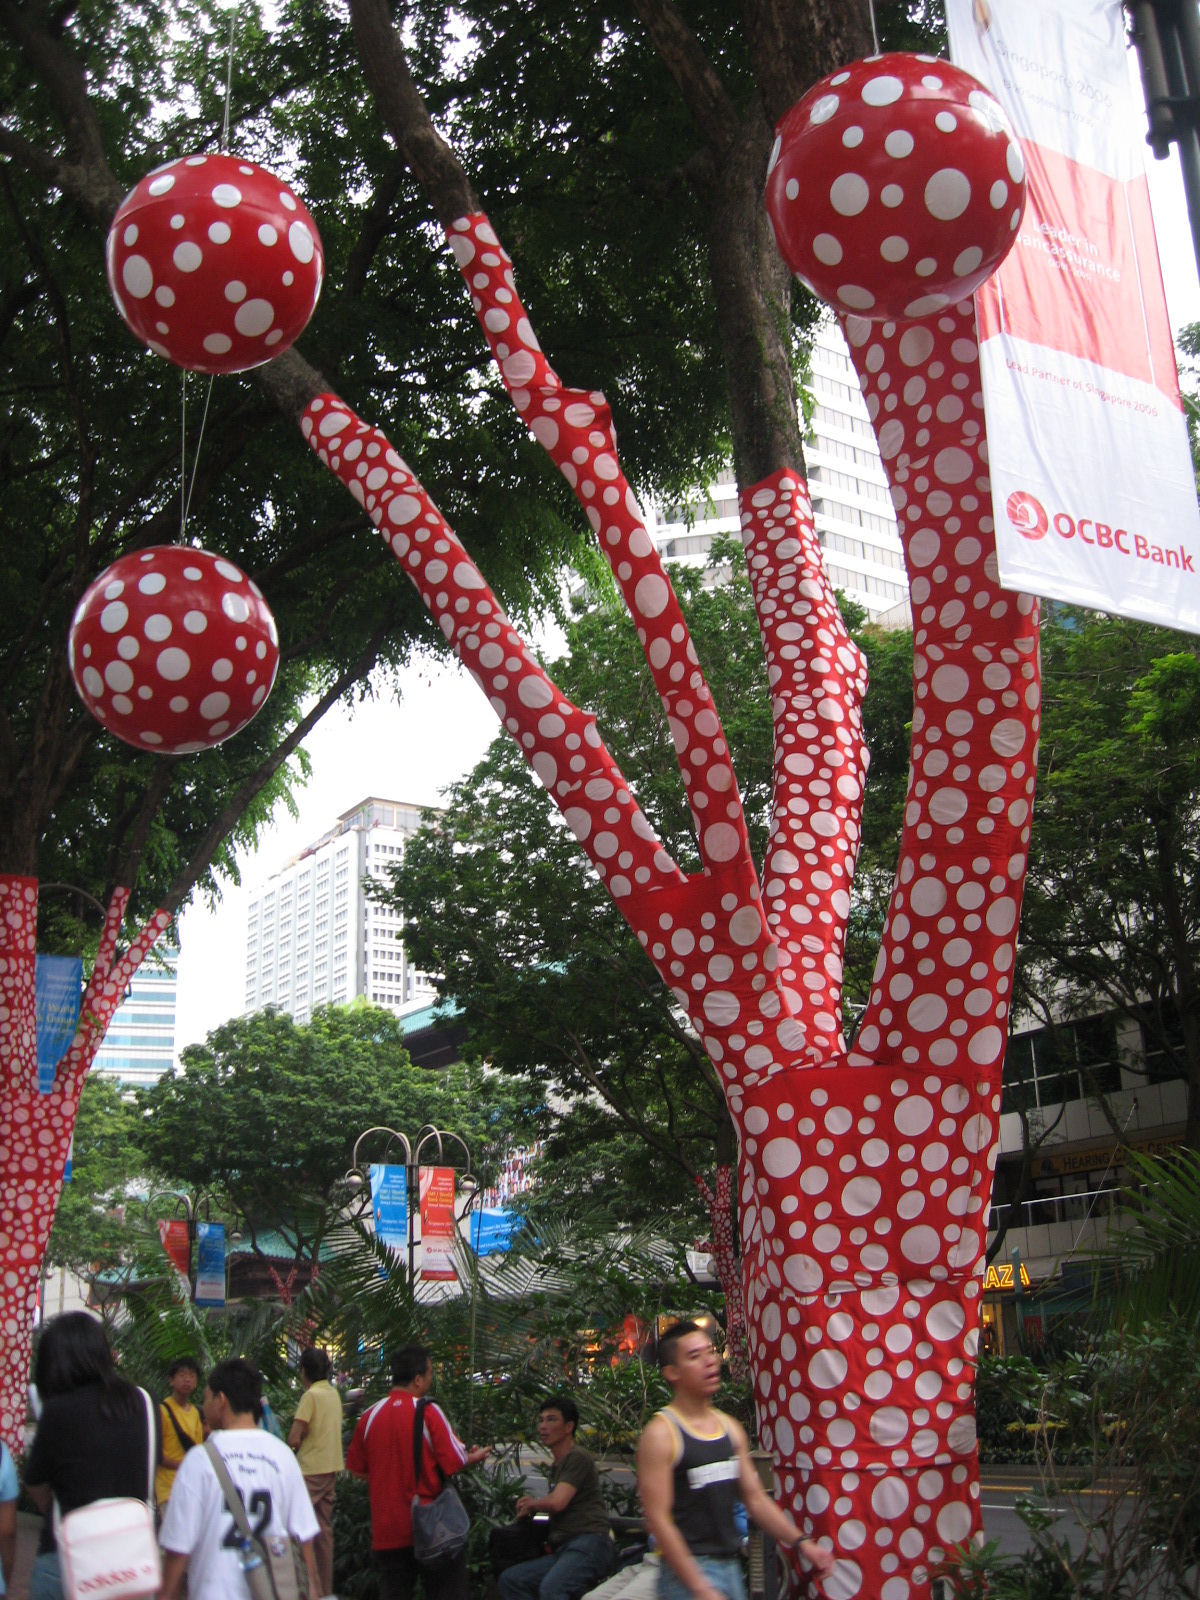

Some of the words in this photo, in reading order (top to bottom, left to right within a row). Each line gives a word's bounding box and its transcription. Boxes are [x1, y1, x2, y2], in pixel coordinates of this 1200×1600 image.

[1076, 79, 1112, 108] 2006
[1032, 216, 1081, 248] Leader
[1085, 238, 1099, 257] in
[1005, 358, 1028, 374] Lead
[1032, 367, 1071, 386] Partner
[1073, 380, 1083, 391] of
[1085, 382, 1132, 409] Singapore
[1134, 401, 1159, 417] 2006
[1053, 512, 1131, 555] OCBC
[1134, 533, 1196, 573] Bank
[1063, 1152, 1110, 1170] HEARING
[983, 1262, 1030, 1289] AZA
